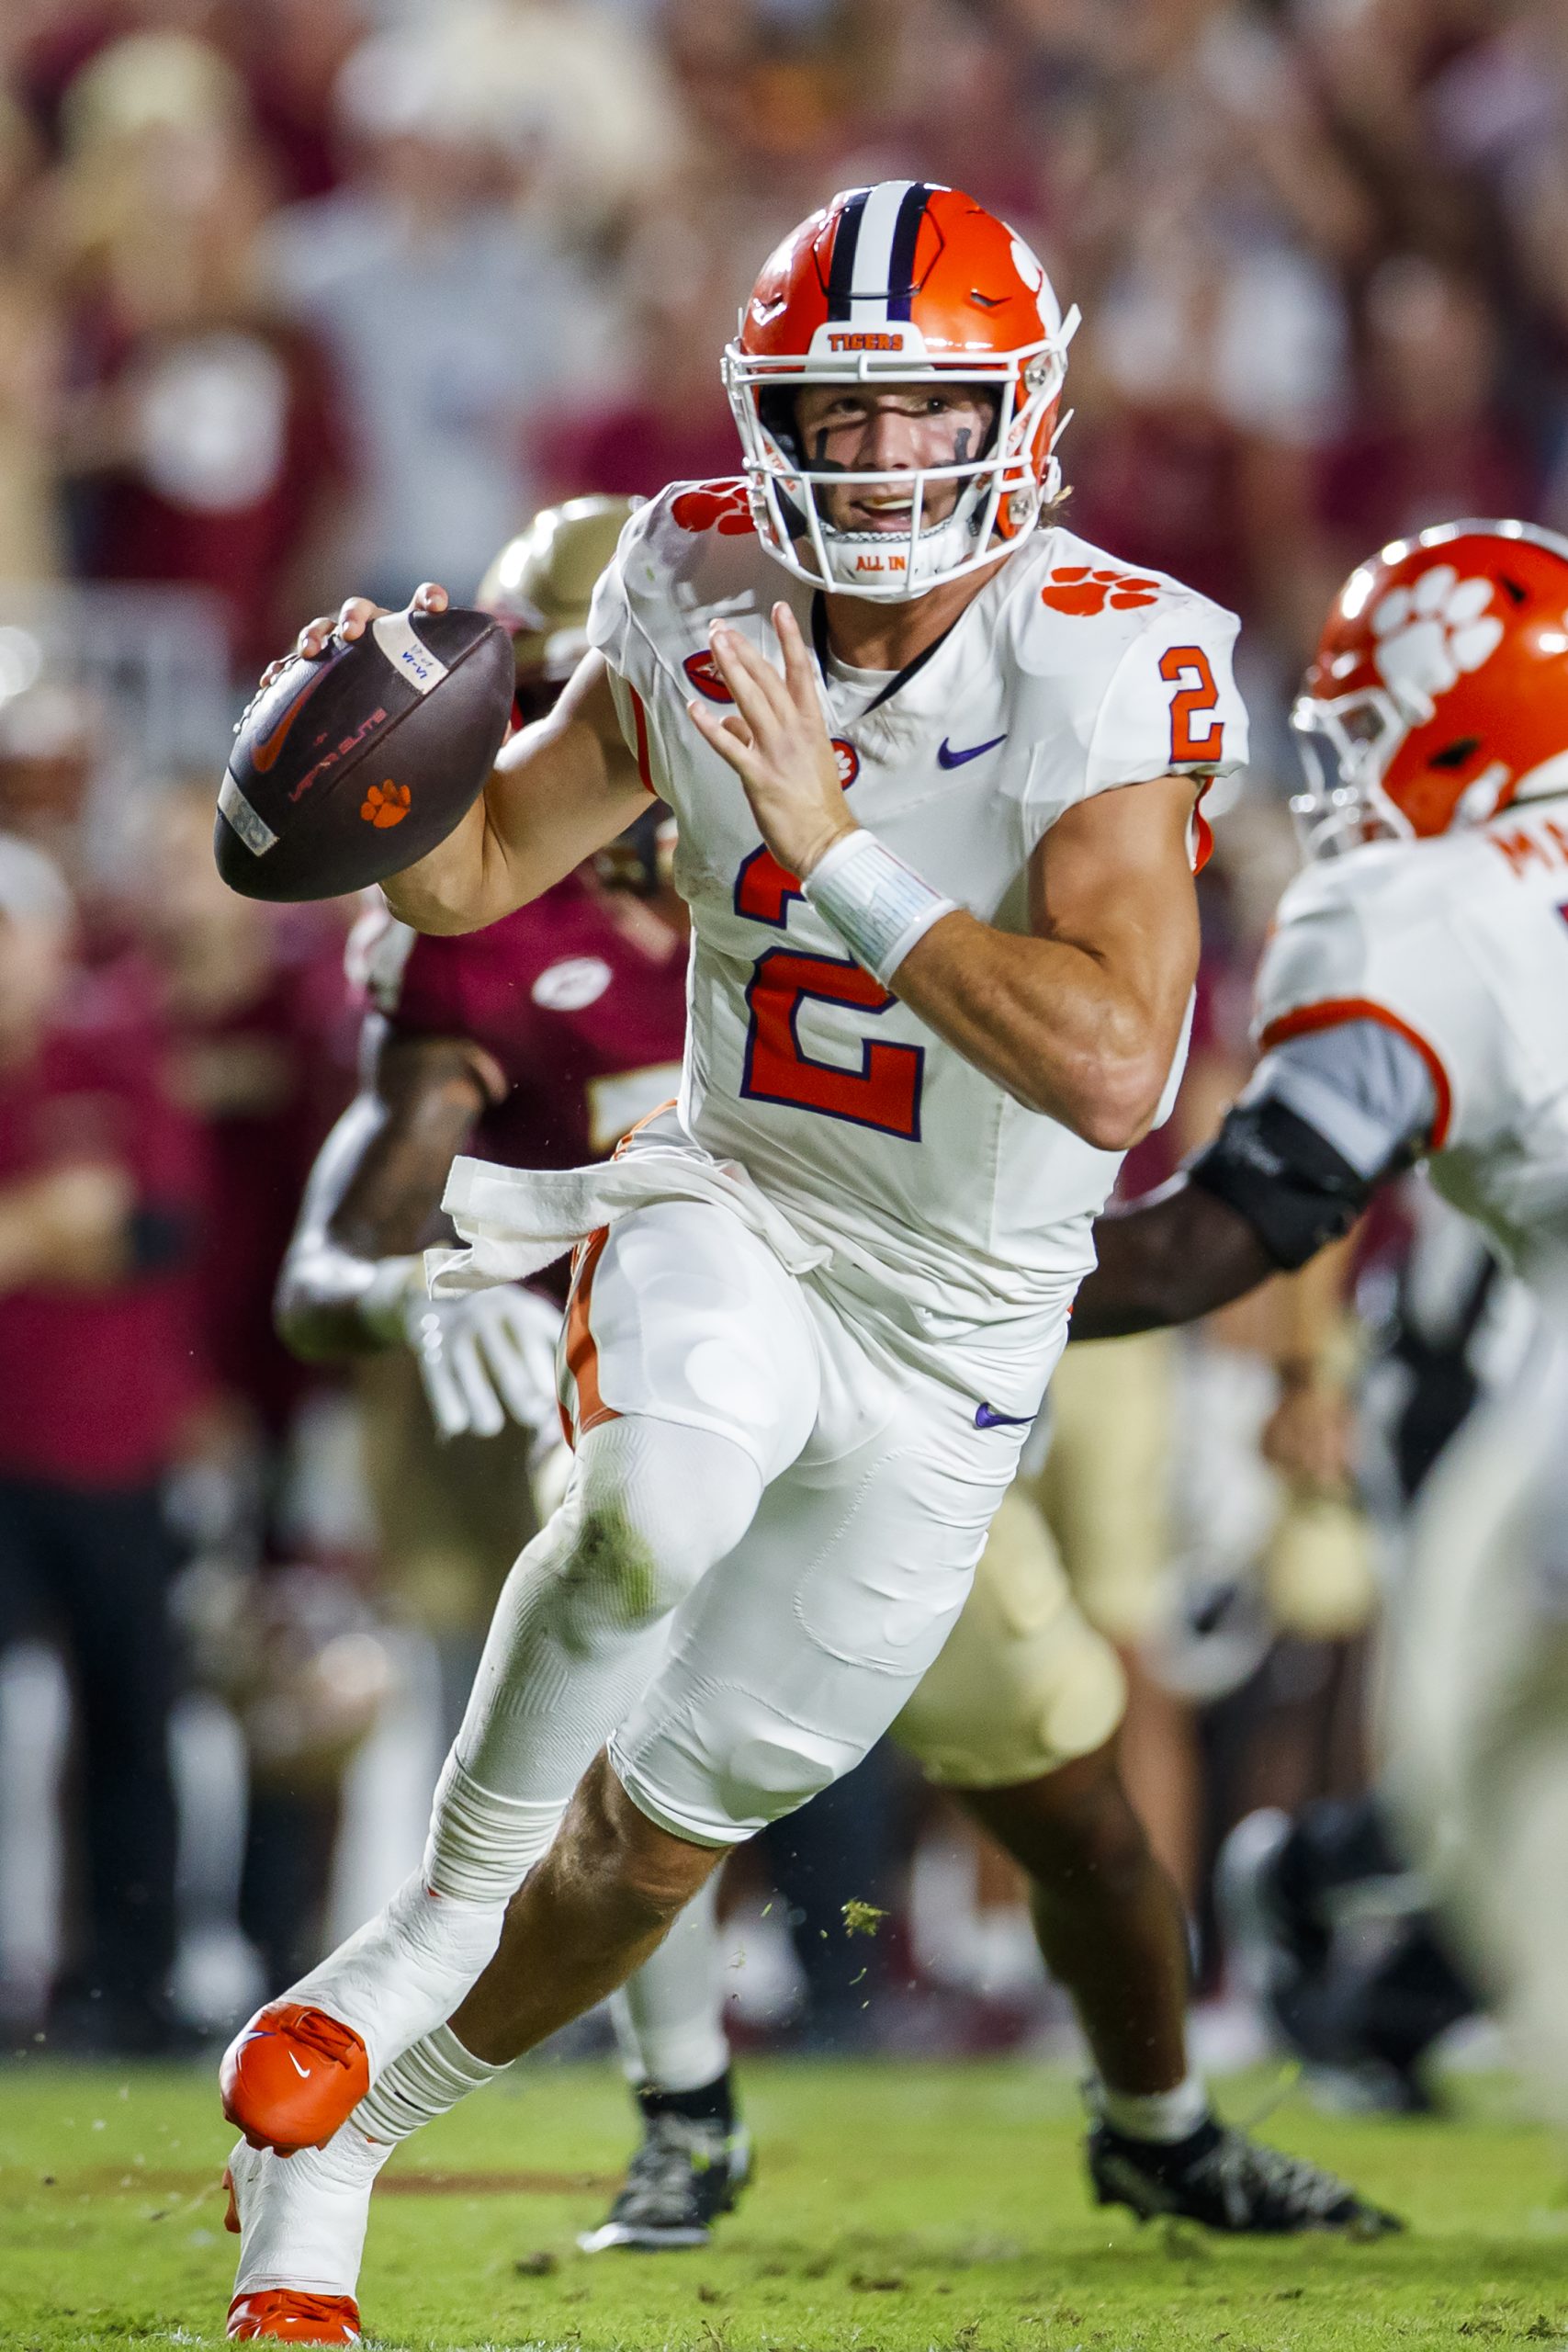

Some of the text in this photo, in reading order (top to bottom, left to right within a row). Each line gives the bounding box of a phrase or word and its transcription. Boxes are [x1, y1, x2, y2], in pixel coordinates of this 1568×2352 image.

[828, 334, 904, 352] TIGERS
[856, 556, 906, 571] ALL IN
[1158, 646, 1224, 763] 2
[735, 842, 925, 1142] 2
